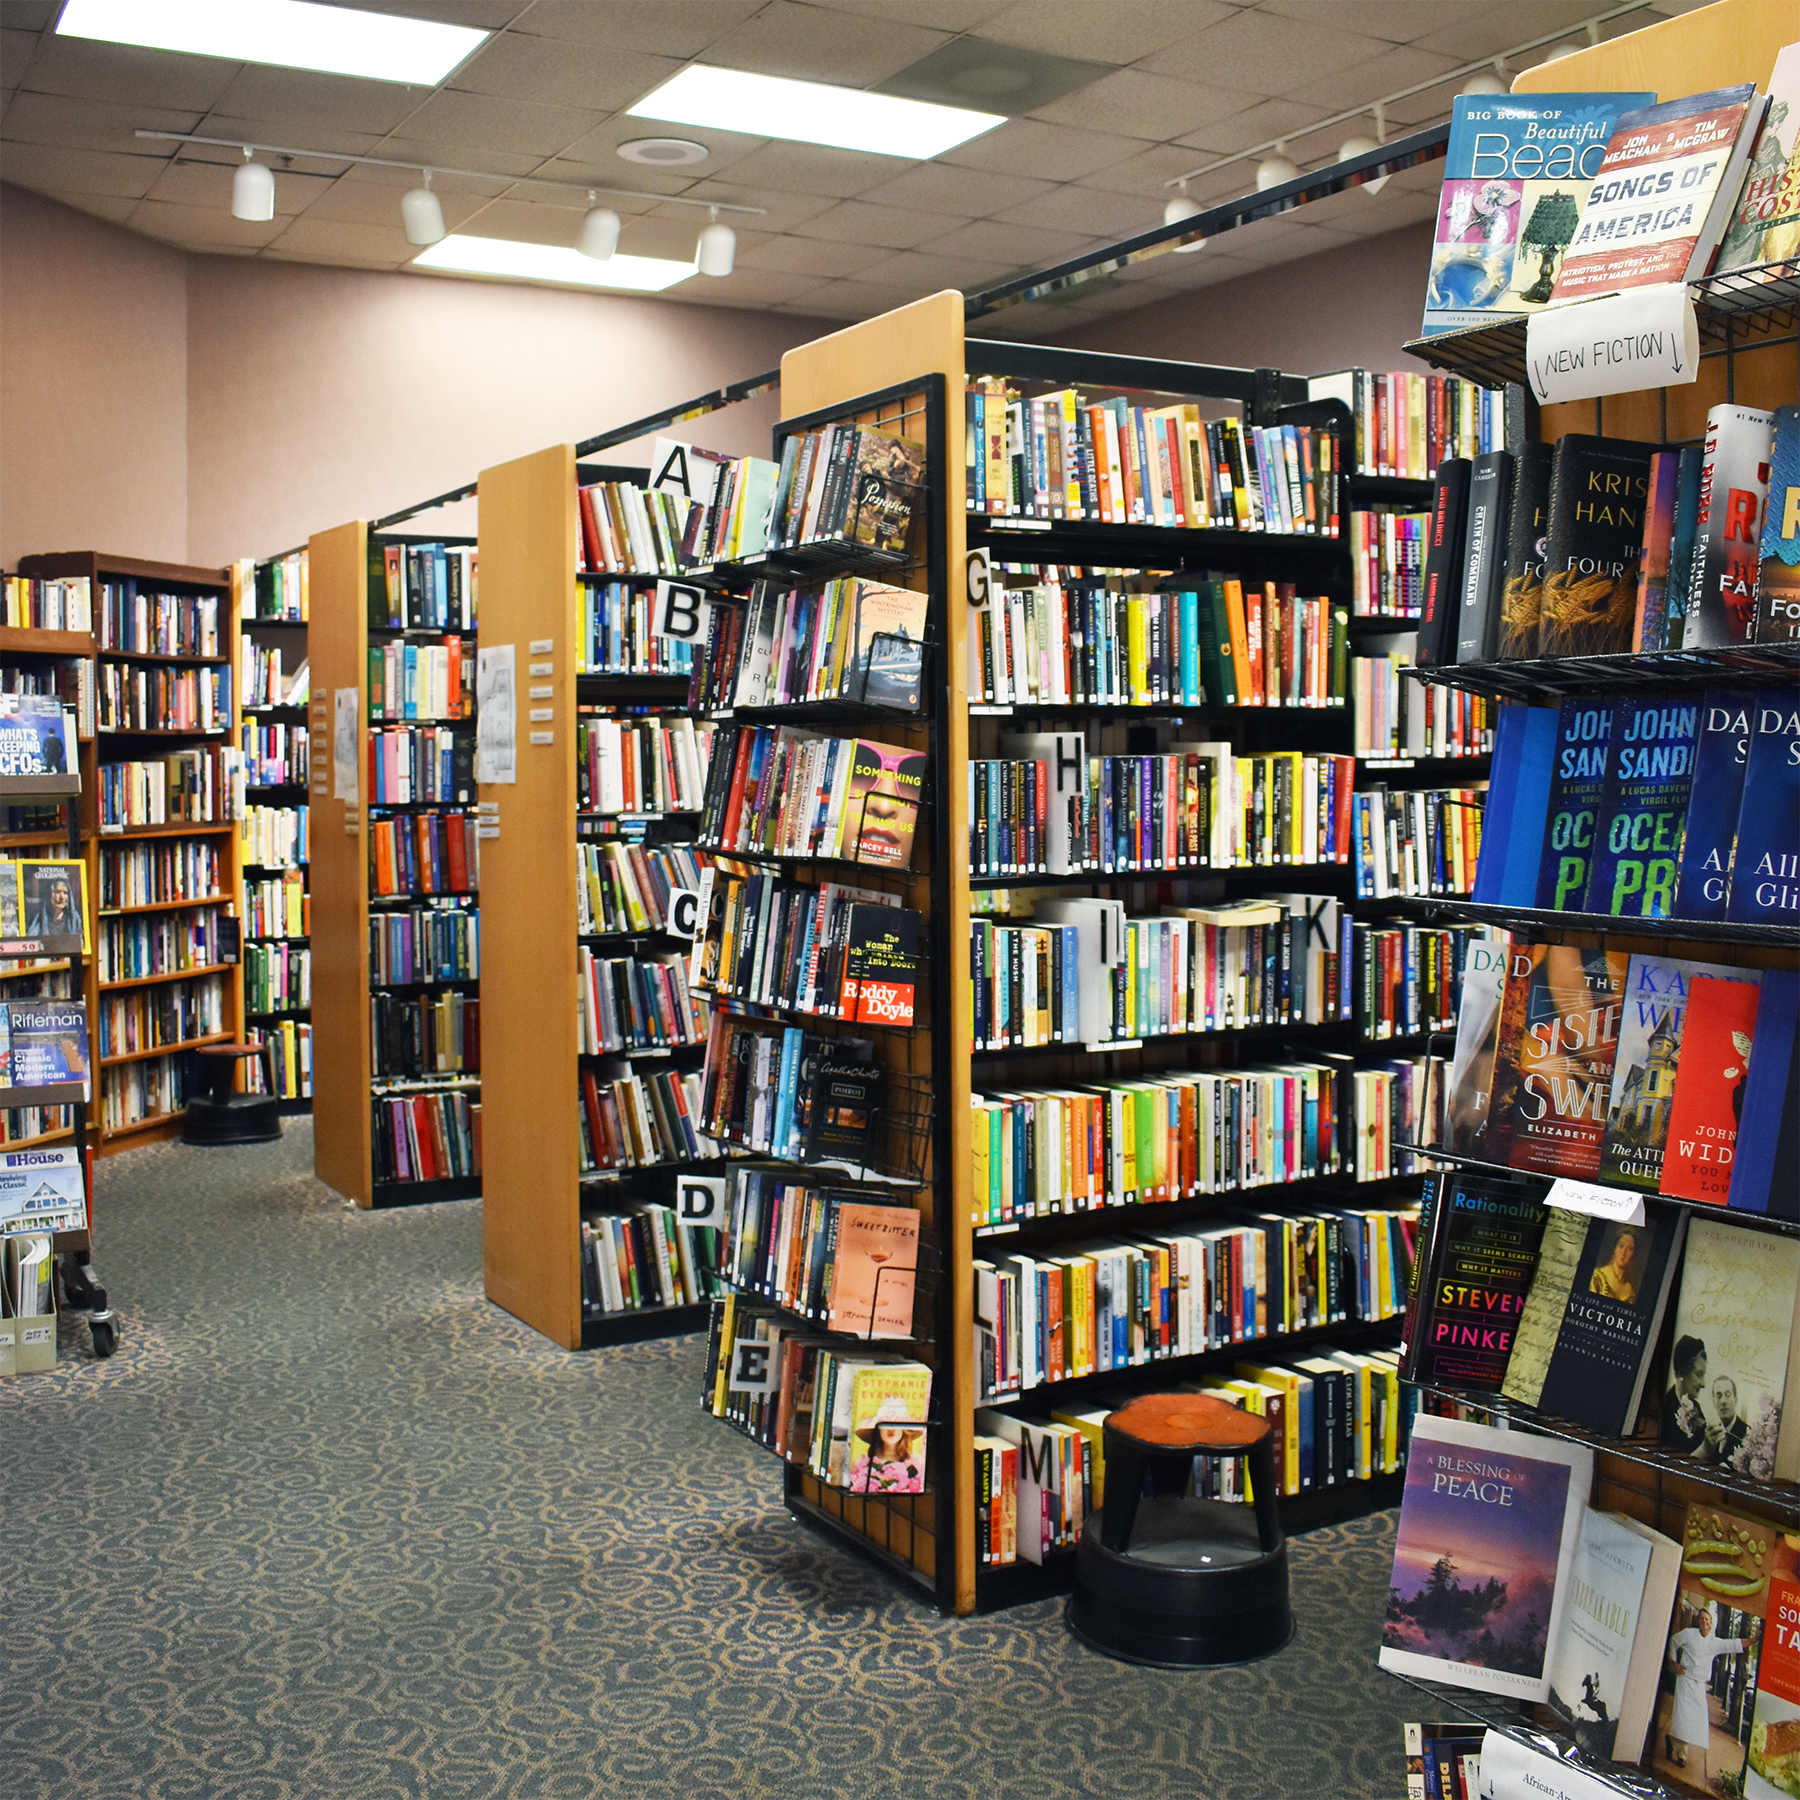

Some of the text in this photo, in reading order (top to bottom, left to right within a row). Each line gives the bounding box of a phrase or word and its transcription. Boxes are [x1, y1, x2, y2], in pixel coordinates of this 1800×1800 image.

[1467, 110, 1562, 120] BIG BOOK OF
[1694, 119, 1718, 133] TIM
[1524, 121, 1607, 145] Beautiful
[1622, 135, 1649, 150] JON
[1602, 143, 1662, 165] MEACHAM
[1673, 128, 1731, 149] MCGRAW
[1587, 161, 1717, 207] SONGS OF
[1576, 203, 1694, 246] AMERICA
[1560, 251, 1681, 278] PATRIOTISM, PROTEST, AND THE
[1562, 277, 1586, 287] MUSIC
[1587, 273, 1607, 282] THAT
[1608, 268, 1631, 278] MADE
[1639, 262, 1670, 274] NATION
[1544, 331, 1662, 376] NEW FICTION
[1748, 415, 1761, 423] New
[653, 445, 692, 498] A
[1086, 449, 1098, 502] LITTLE DEATHS
[861, 477, 912, 516] Possession
[1434, 487, 1449, 547] DAVID BALDACCI
[1465, 506, 1483, 606] CHAIN OF COMMAND
[1567, 555, 1624, 578] FOUR
[967, 551, 990, 607] G
[1692, 533, 1709, 619] FAITHLESS
[663, 584, 701, 639] B
[878, 607, 905, 616] MYSTERY
[0, 728, 38, 741] WHAT'S
[1624, 707, 1697, 742] JOHN
[855, 764, 922, 786] SOMETHING
[1057, 737, 1082, 792] H
[1570, 785, 1597, 794] LUCAS
[1629, 785, 1656, 795] LUCAS
[1640, 796, 1669, 806] VIRGIL
[883, 846, 903, 856] BELL
[1754, 851, 1799, 879] All
[674, 894, 697, 935] C
[816, 890, 827, 922] MICHAEL
[1305, 897, 1331, 950] K
[865, 940, 893, 951] Woman
[884, 933, 900, 943] The
[867, 956, 888, 966] Into
[844, 982, 898, 1001] Roddy
[1584, 977, 1620, 991] THE
[12, 1013, 83, 1028] Rifleman
[866, 1000, 914, 1020] Doyle
[14, 1054, 52, 1063] Classic
[15, 1063, 55, 1072] Modern
[15, 1071, 66, 1081] American
[834, 1086, 864, 1097] POIROT
[1527, 1124, 1597, 1141] ELIZABETH
[1696, 1125, 1738, 1141] JOHN
[17, 1153, 64, 1166] House
[1611, 1143, 1632, 1157] The
[1691, 1164, 1719, 1177] YOU
[681, 1184, 715, 1219] D
[1423, 1180, 1435, 1228] STEVEN
[1455, 1192, 1546, 1222] Rationality
[1477, 1229, 1497, 1238] WHAT
[1725, 1234, 1776, 1252] SHEPHARD
[1454, 1243, 1471, 1251] WHY
[1482, 1248, 1506, 1257] SEEMS
[1507, 1252, 1535, 1262] SCARCE
[1461, 1263, 1479, 1271] WHY
[1490, 1267, 1522, 1278] MATTERS
[1441, 1284, 1525, 1314] STEVEN
[1585, 1296, 1600, 1307] LIFE
[1616, 1306, 1637, 1319] TIMES
[1569, 1302, 1643, 1336] VICTORIA
[1565, 1316, 1600, 1333] DOROTHY
[1602, 1328, 1639, 1346] MARSHALL
[736, 1345, 771, 1383] E
[861, 1391, 926, 1400] EVANOVICH
[863, 1379, 927, 1389] STEPHANIE
[1020, 1424, 1053, 1490] M
[1427, 1456, 1527, 1482] A BLESSING OF
[1433, 1472, 1513, 1507] PEACE
[1447, 1663, 1541, 1689] WELLERAN POLTARNEES
